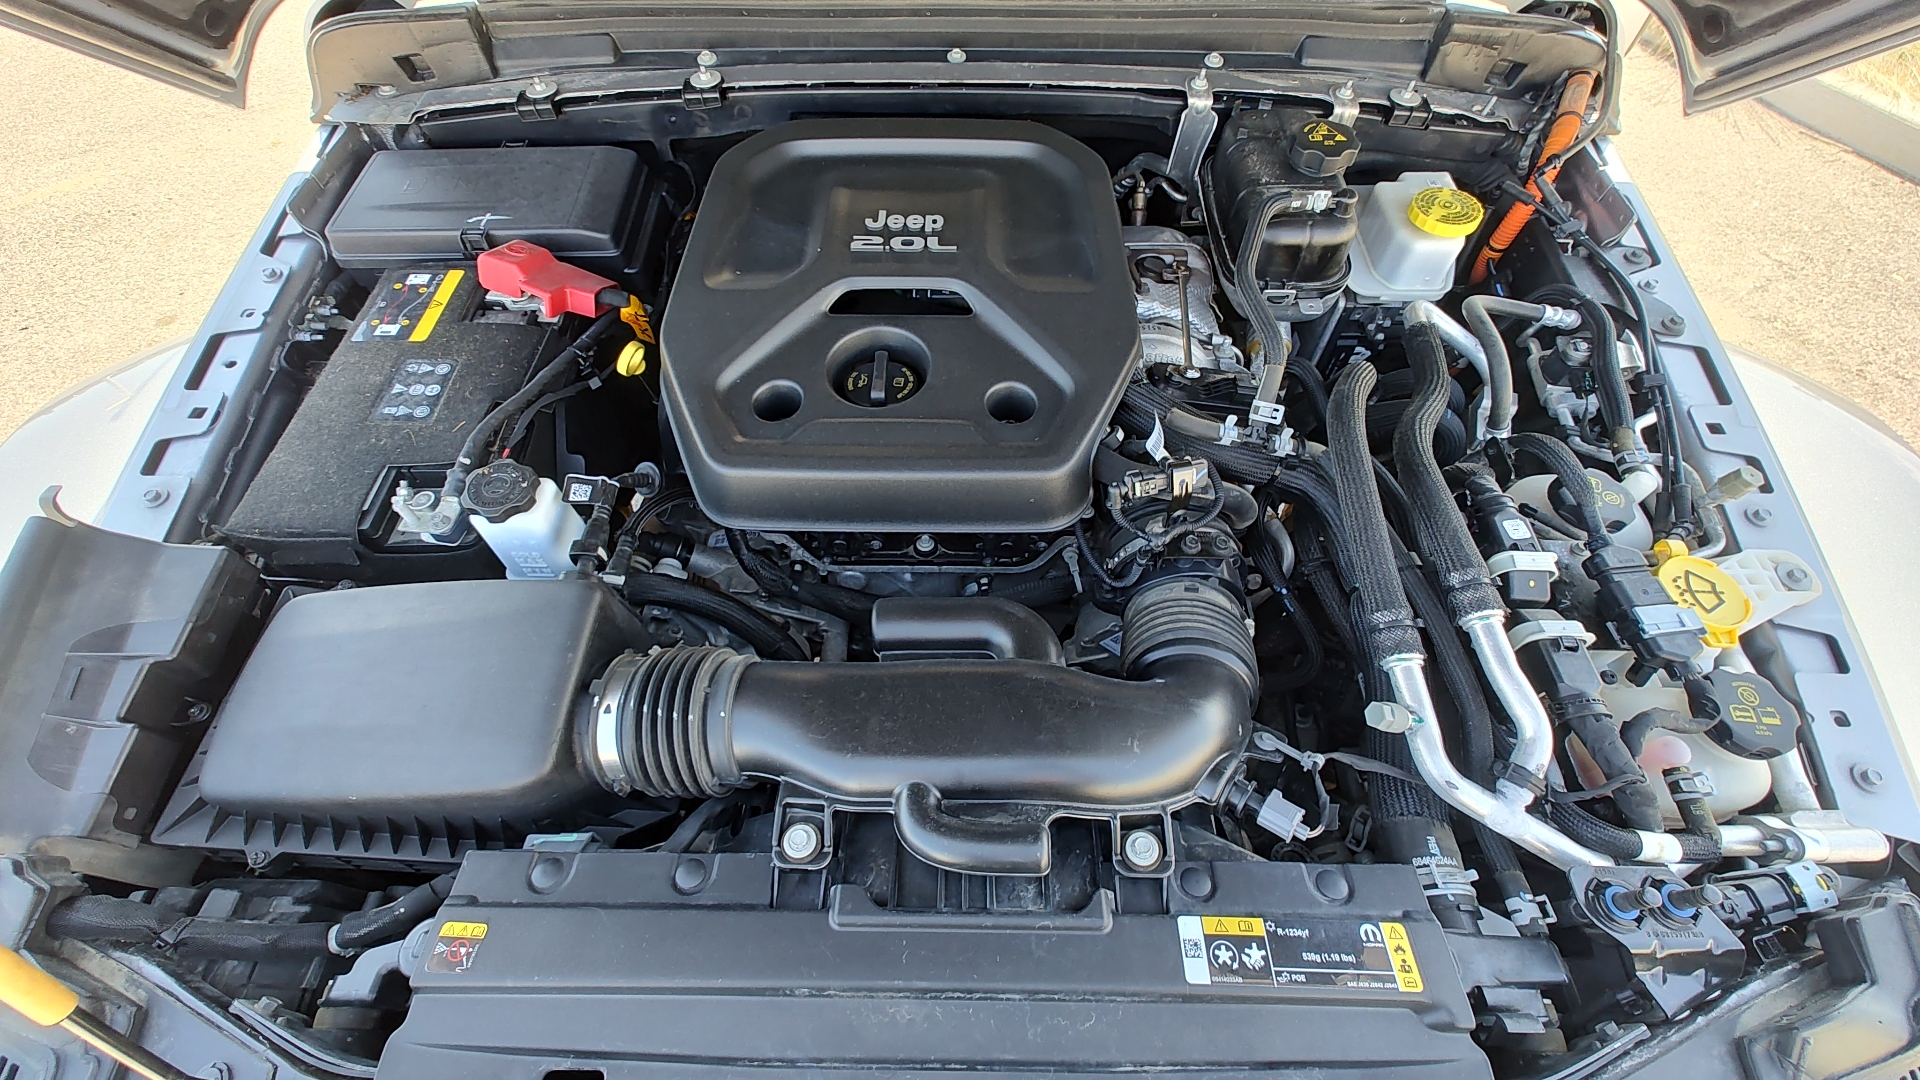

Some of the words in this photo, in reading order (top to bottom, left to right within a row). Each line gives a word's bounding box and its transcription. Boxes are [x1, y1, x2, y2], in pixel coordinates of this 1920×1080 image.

[864, 209, 944, 234] Jeep
[850, 235, 957, 252] 2.0L
[1426, 835, 1440, 856] PHEV
[1276, 927, 1310, 939] R-1234yf
[1322, 952, 1340, 963] (1.19
[1341, 953, 1357, 964] lbs)
[1291, 974, 1307, 982] POE
